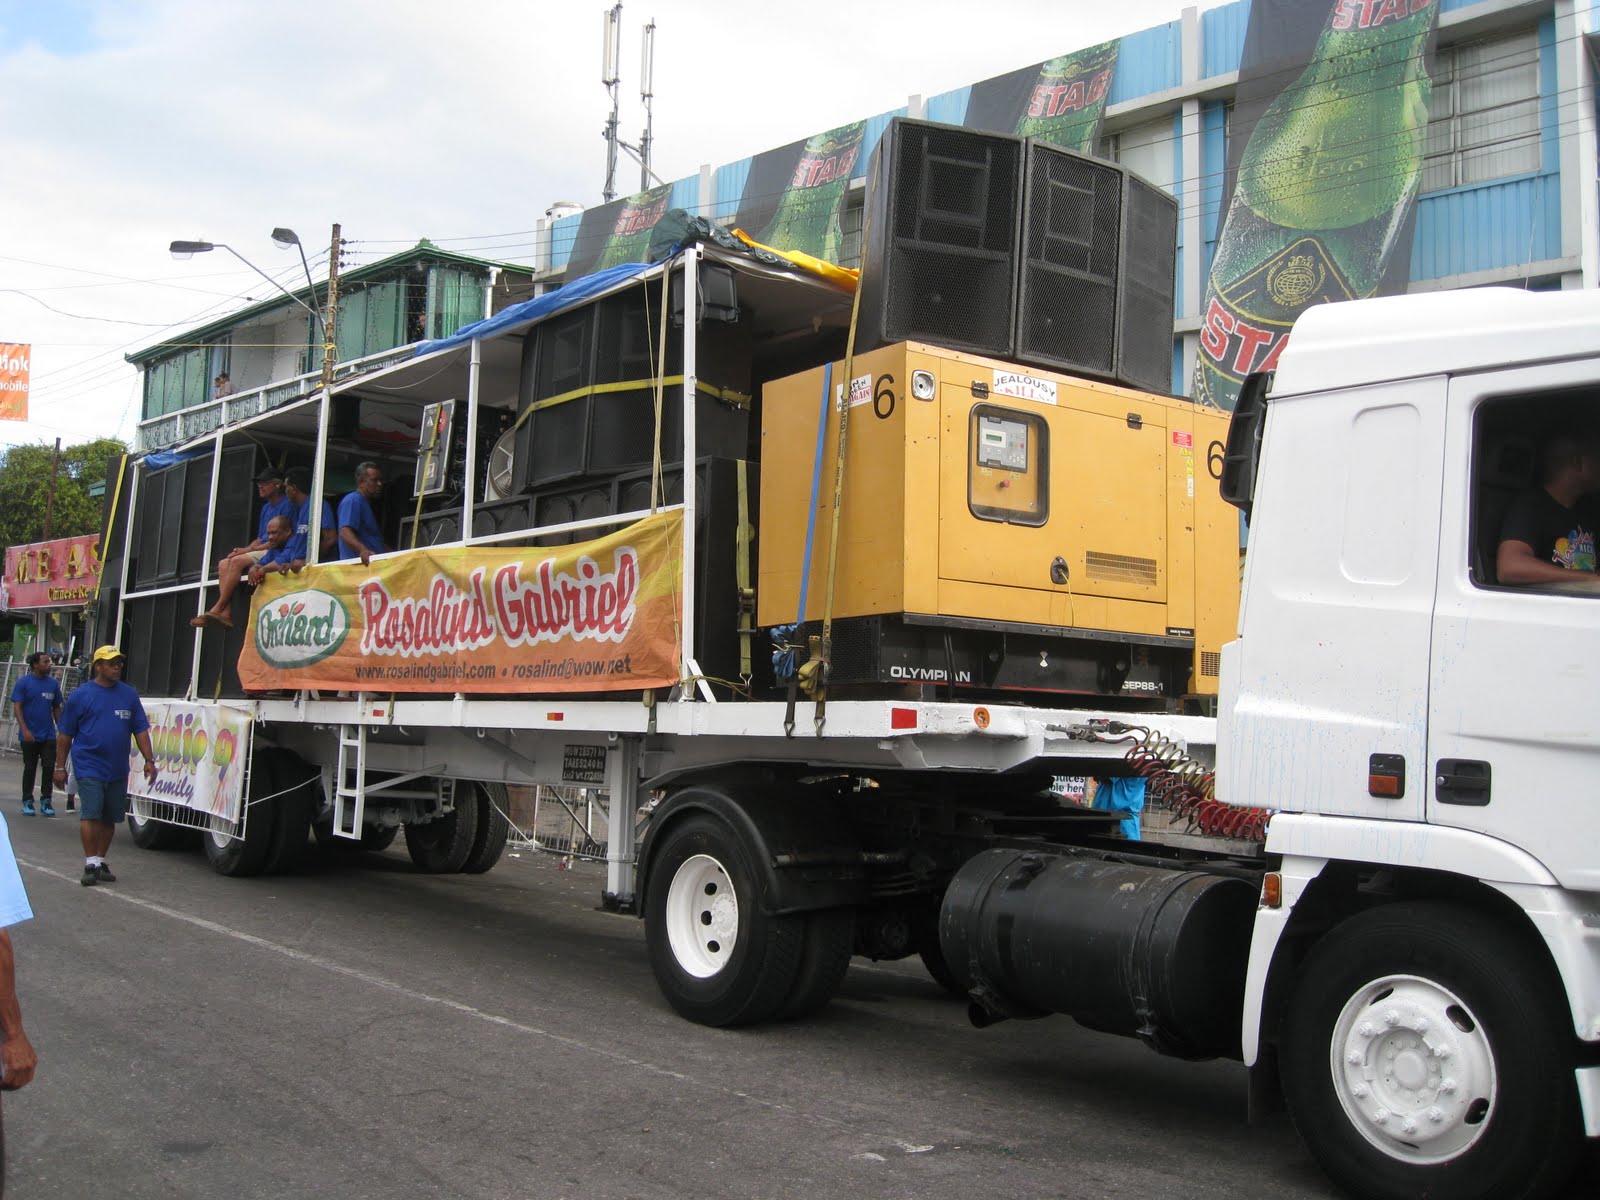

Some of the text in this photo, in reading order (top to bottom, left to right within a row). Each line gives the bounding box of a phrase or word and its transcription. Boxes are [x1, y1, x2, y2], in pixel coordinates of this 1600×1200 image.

[1027, 69, 1112, 118] STAG
[792, 146, 858, 188] STAG
[873, 373, 896, 420] 6
[994, 375, 1056, 397] JEALOUSY
[1207, 440, 1226, 480] 6
[360, 549, 637, 653] Rosalind Gabriel
[260, 599, 337, 650] Orchard
[355, 653, 632, 683] www.rosalindgabriel.com rosalind@wow.net
